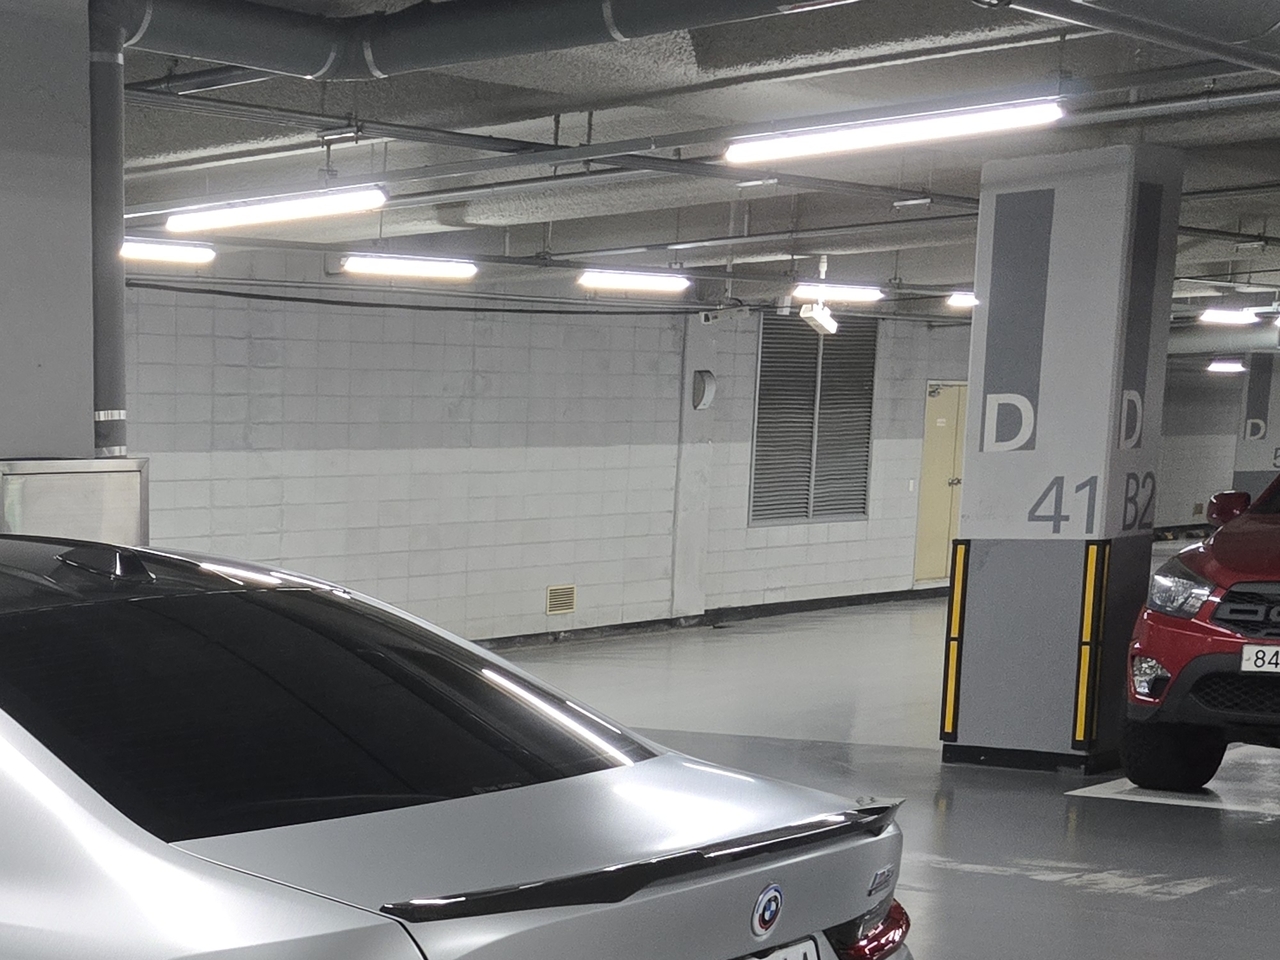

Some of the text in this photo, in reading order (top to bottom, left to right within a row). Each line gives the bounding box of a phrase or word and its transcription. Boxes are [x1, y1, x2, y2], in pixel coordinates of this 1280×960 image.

[983, 393, 1034, 452] D
[1120, 389, 1143, 449] D
[1245, 419, 1266, 440] D
[1027, 475, 1098, 534] 41
[1121, 470, 1157, 531] B2
[1254, 650, 1279, 668] 84
